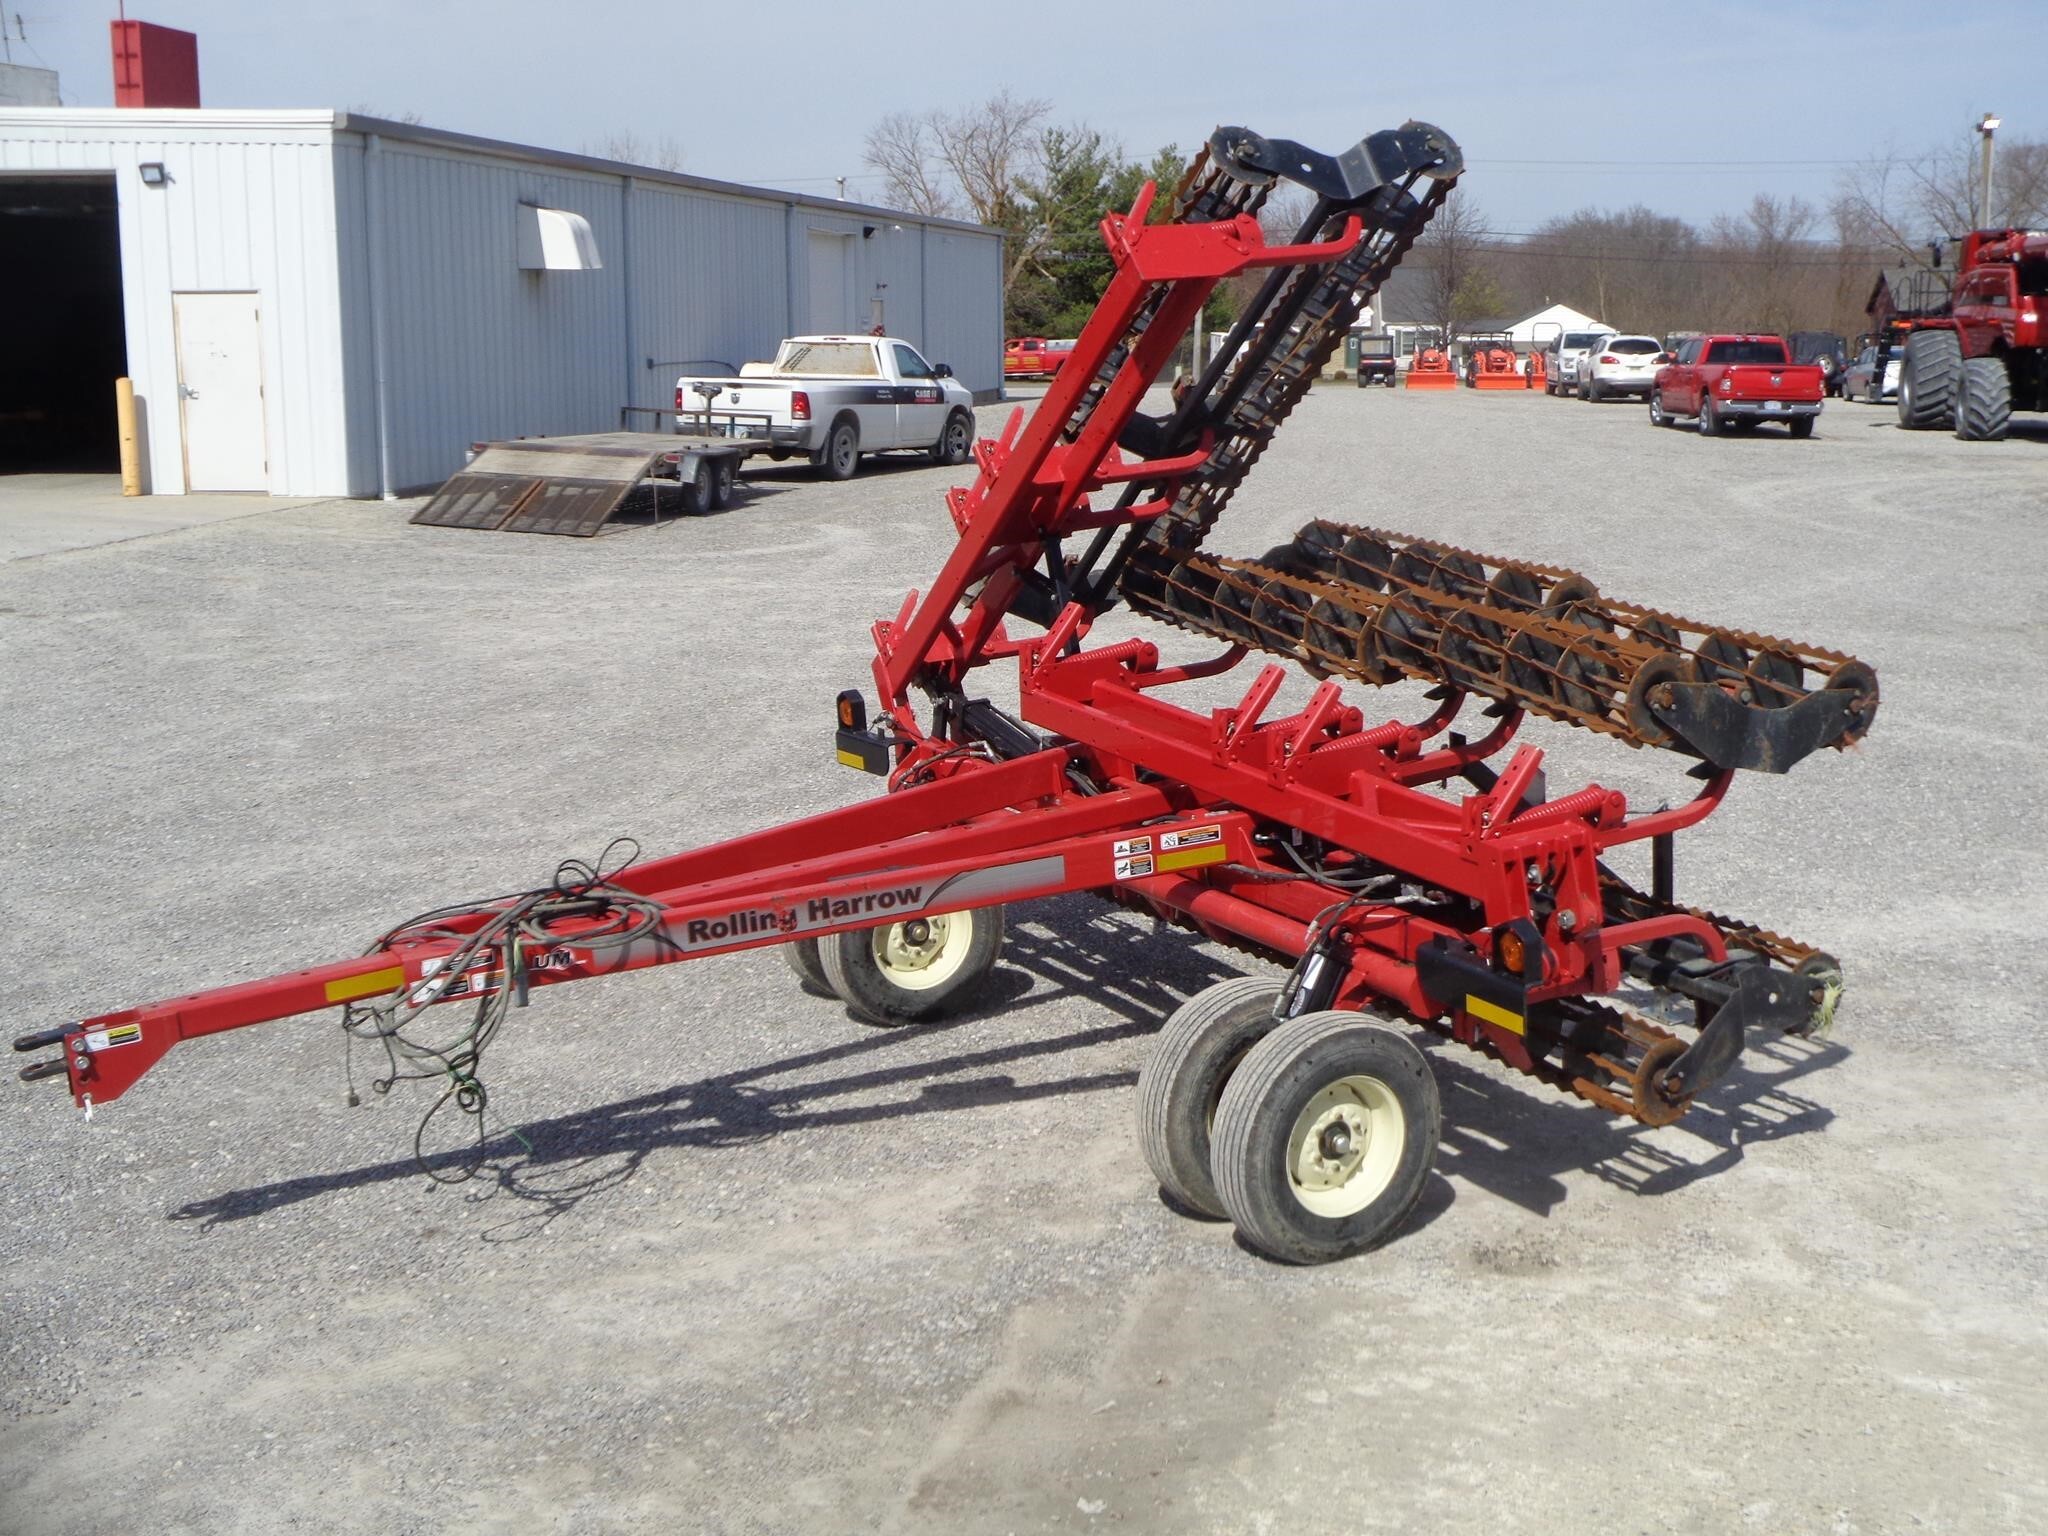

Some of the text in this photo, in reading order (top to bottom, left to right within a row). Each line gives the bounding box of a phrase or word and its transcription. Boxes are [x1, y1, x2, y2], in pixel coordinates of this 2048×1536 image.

[687, 885, 922, 944] Rolling Harrow
[534, 951, 571, 968] UM
